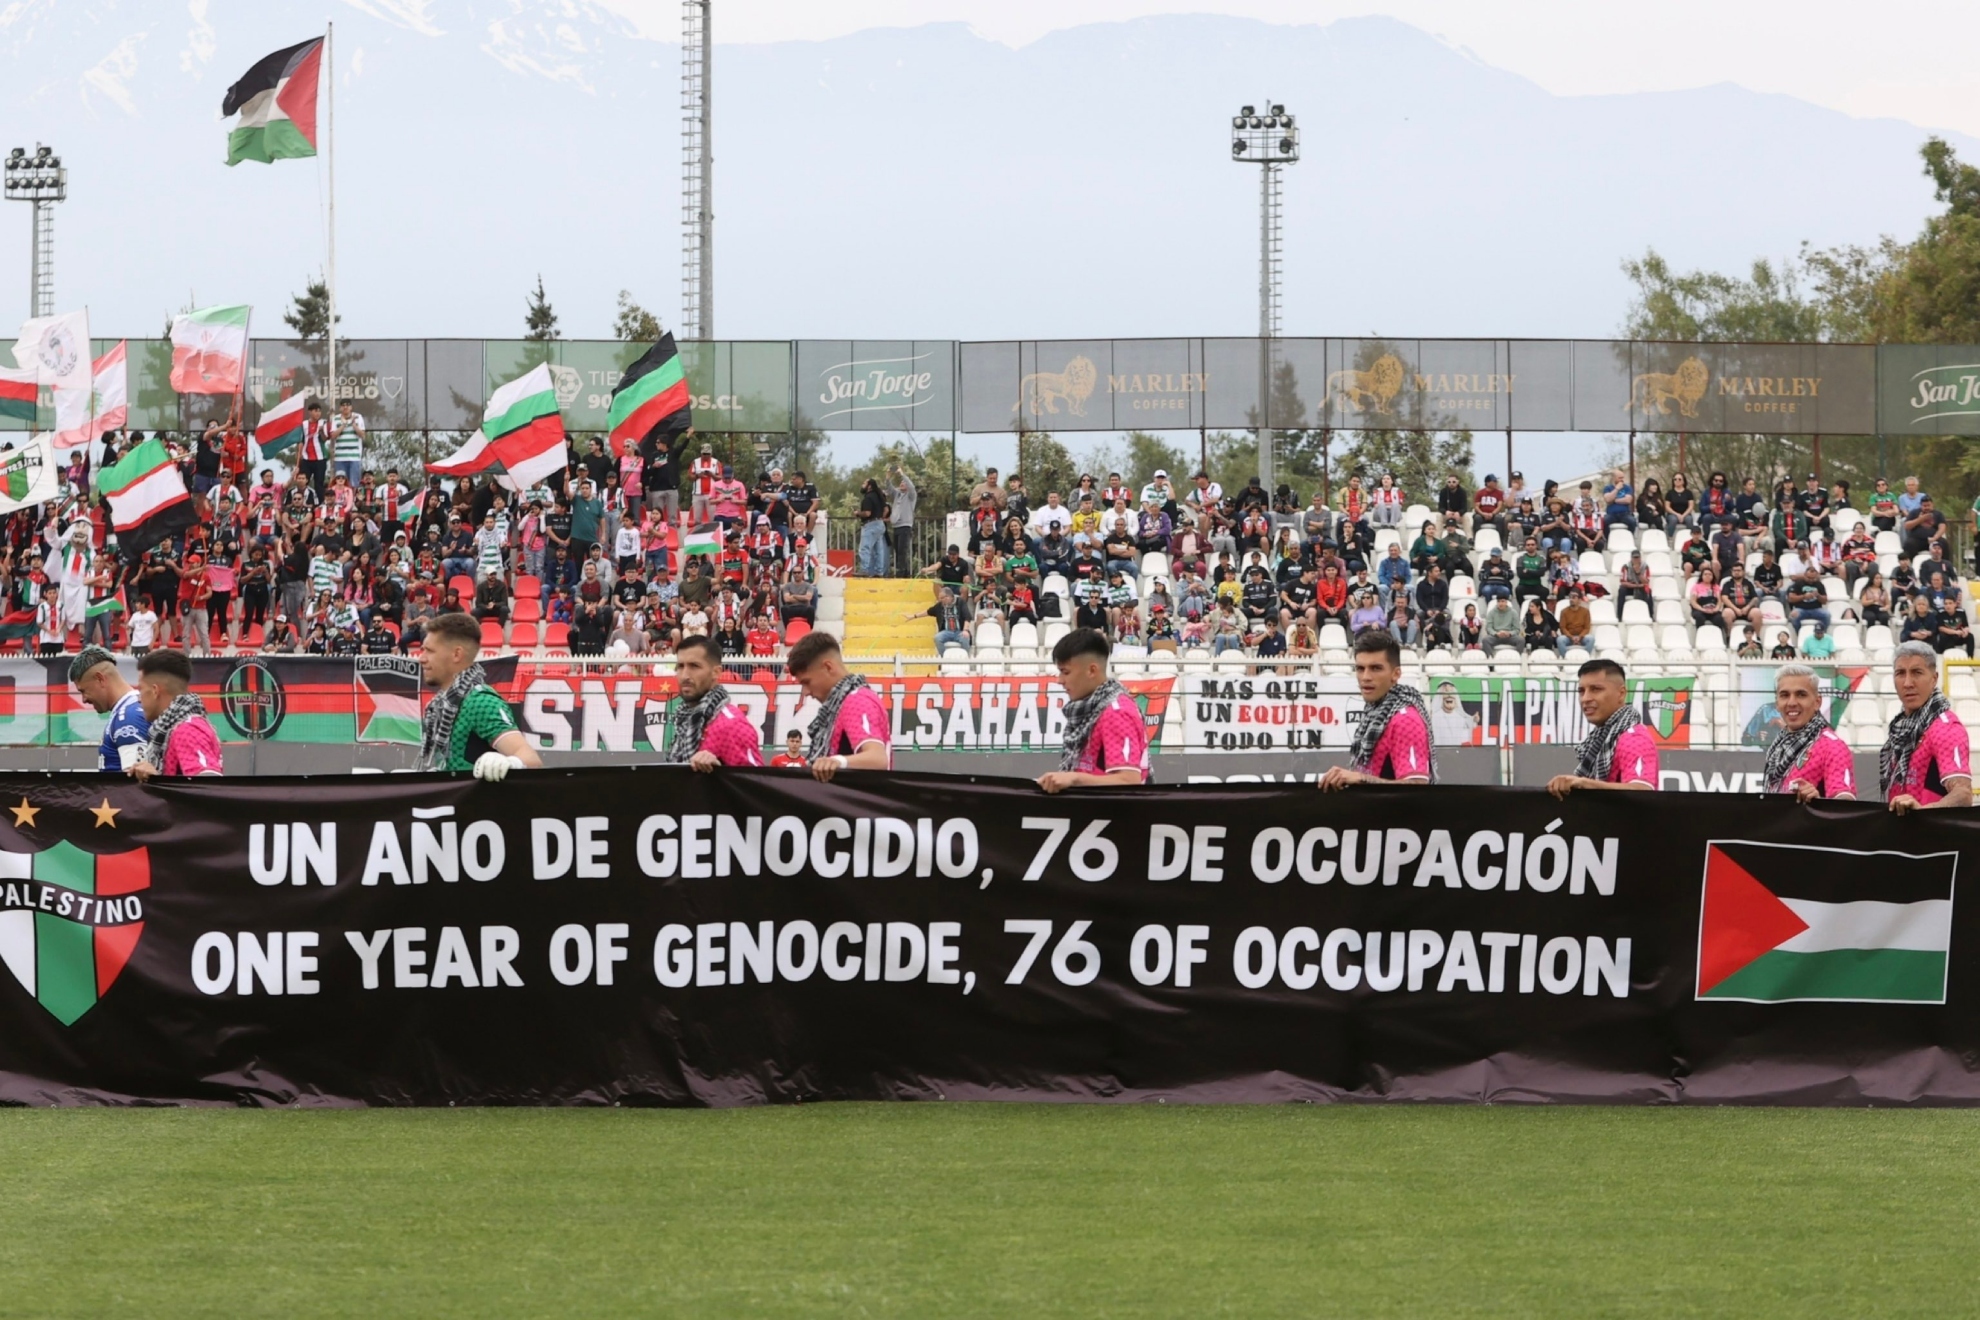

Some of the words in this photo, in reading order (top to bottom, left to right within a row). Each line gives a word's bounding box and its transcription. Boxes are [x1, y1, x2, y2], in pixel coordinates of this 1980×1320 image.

[361, 376, 379, 386] UN
[820, 375, 866, 404] San
[867, 370, 931, 401] Jorge
[1107, 373, 1210, 393] MARLEY
[1413, 373, 1517, 393] MARLEY
[1718, 376, 1822, 396] MARLEY
[304, 386, 379, 400] PUEBLO
[1910, 379, 1958, 408] San
[1133, 399, 1185, 410] COFFEE
[1439, 399, 1491, 410] COFFEE
[1744, 402, 1796, 413] COFFEE
[359, 656, 416, 675] PALESTINO
[1266, 680, 1318, 700] QUE
[870, 682, 1070, 751] LSAHAB
[1196, 702, 1232, 723] UN
[1238, 704, 1339, 726] EQUIPO,
[1481, 679, 1515, 744] LA
[1204, 730, 1273, 751] TODO
[1287, 729, 1323, 749] UN
[249, 822, 336, 885] UN
[362, 806, 505, 885] AÑO
[532, 817, 609, 879] DE
[637, 815, 993, 890] GENOCIDIO,
[1022, 818, 1118, 881] 76
[1149, 825, 1226, 881] DE
[1251, 818, 1618, 895] OCUPACIÓN
[0, 883, 142, 924] ALESTINO
[192, 932, 319, 995] ONE
[345, 926, 524, 989] YEAR
[550, 924, 628, 985] OF
[654, 921, 975, 994] GENOCIDE,
[1005, 920, 1100, 985] 76
[1130, 925, 1209, 986] OF
[1234, 927, 1631, 997] OCCUPATION
